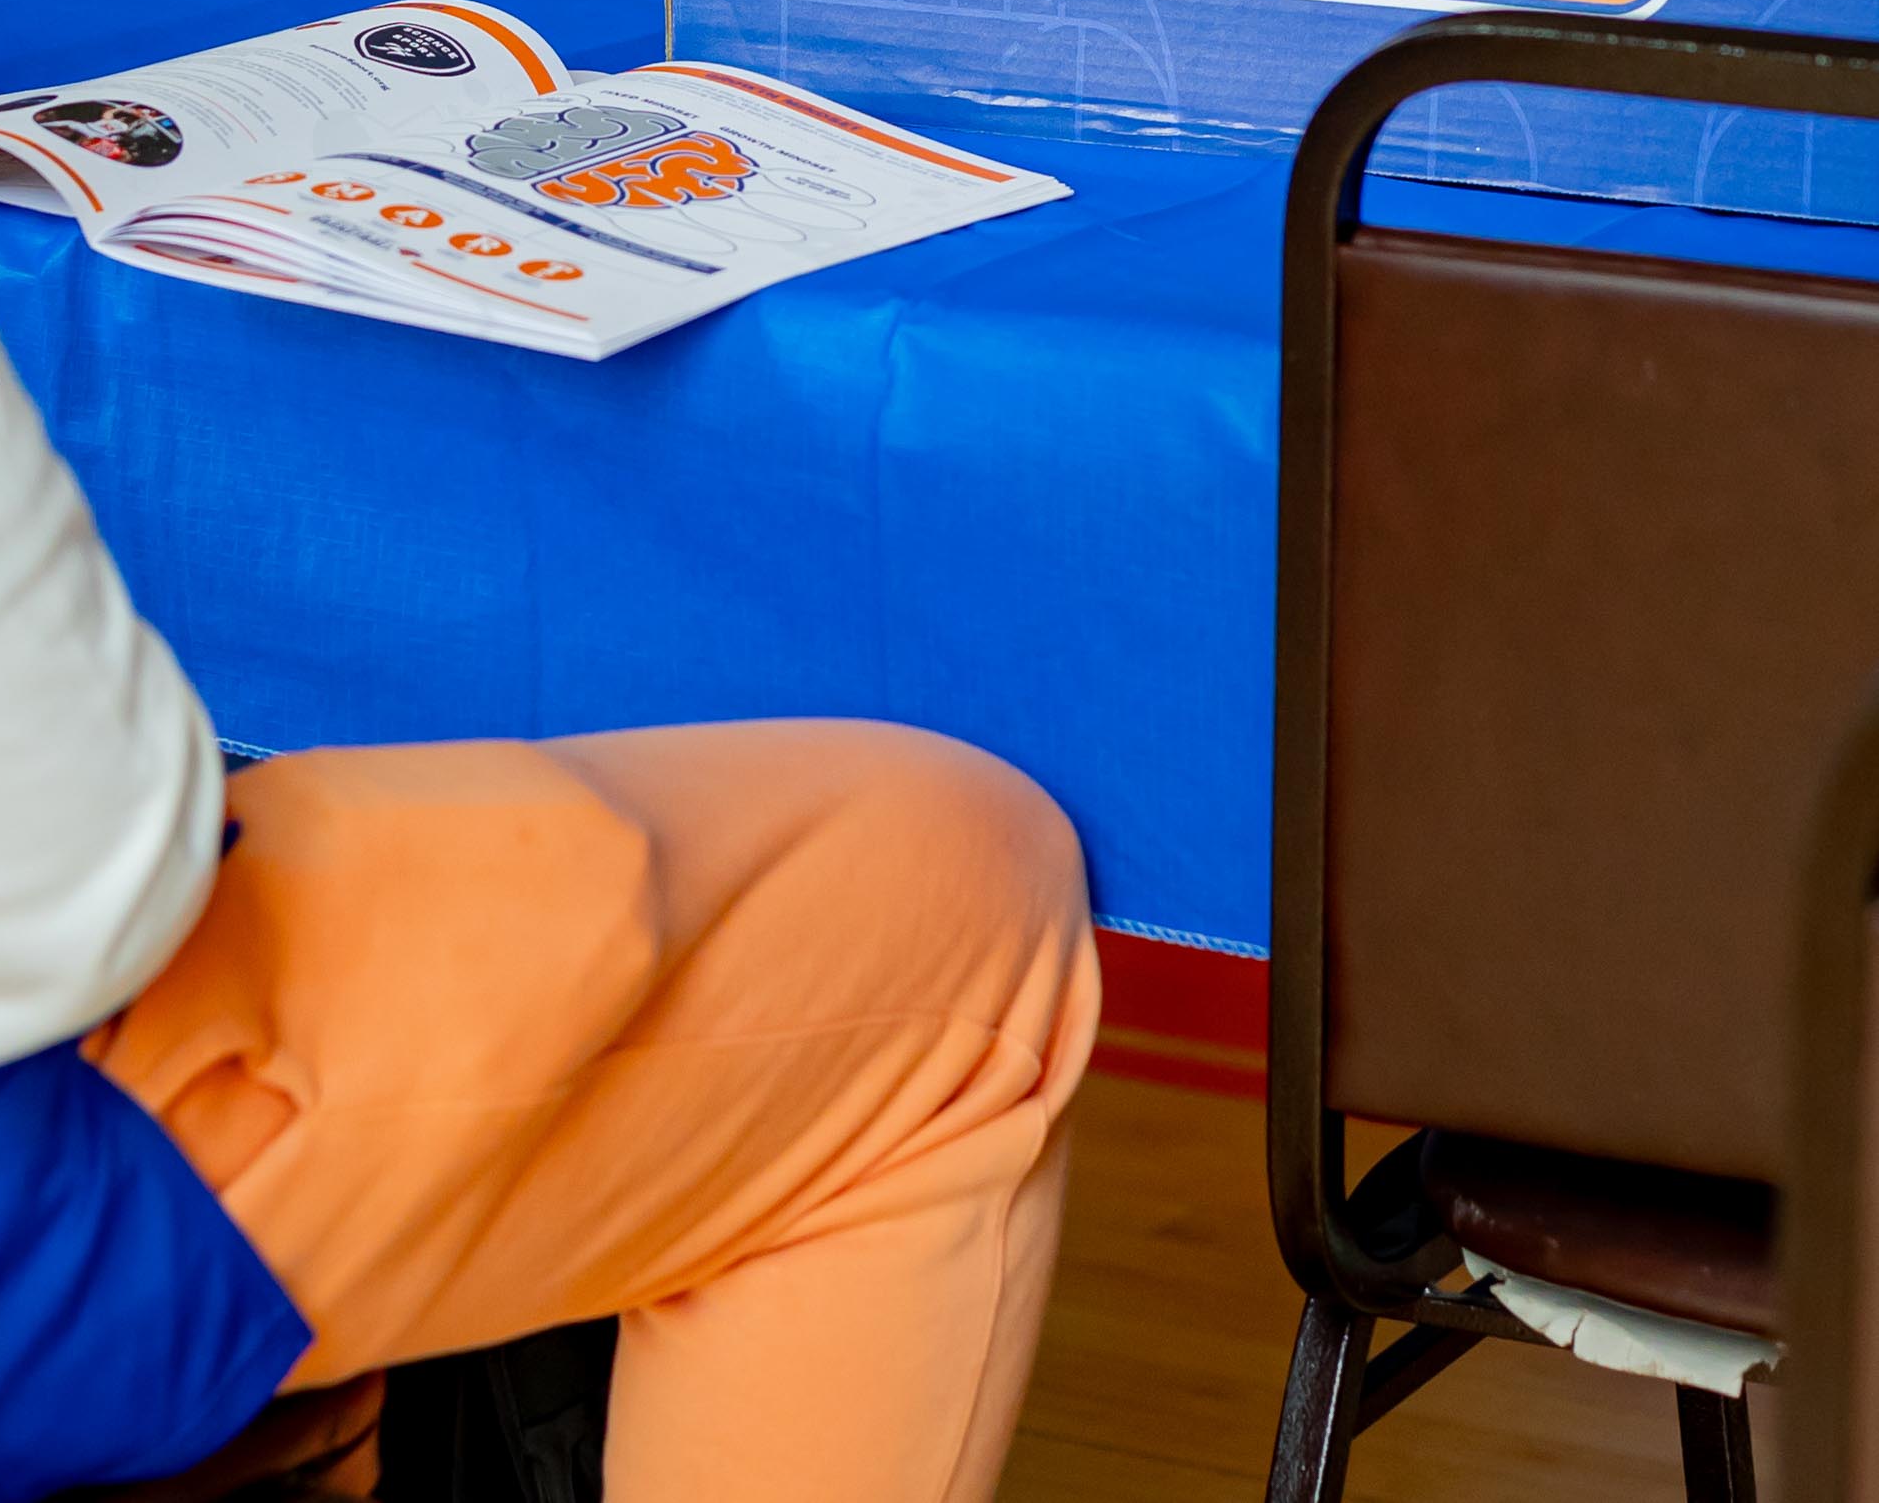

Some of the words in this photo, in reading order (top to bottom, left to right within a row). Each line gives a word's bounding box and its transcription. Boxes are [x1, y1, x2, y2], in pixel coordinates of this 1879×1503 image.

[392, 34, 436, 57] SPORT
[403, 27, 459, 59] SCIENCE
[416, 38, 430, 46] OF
[643, 98, 701, 119] MINDSET
[719, 125, 773, 151] GROWTH
[776, 149, 838, 173] MINDSET
